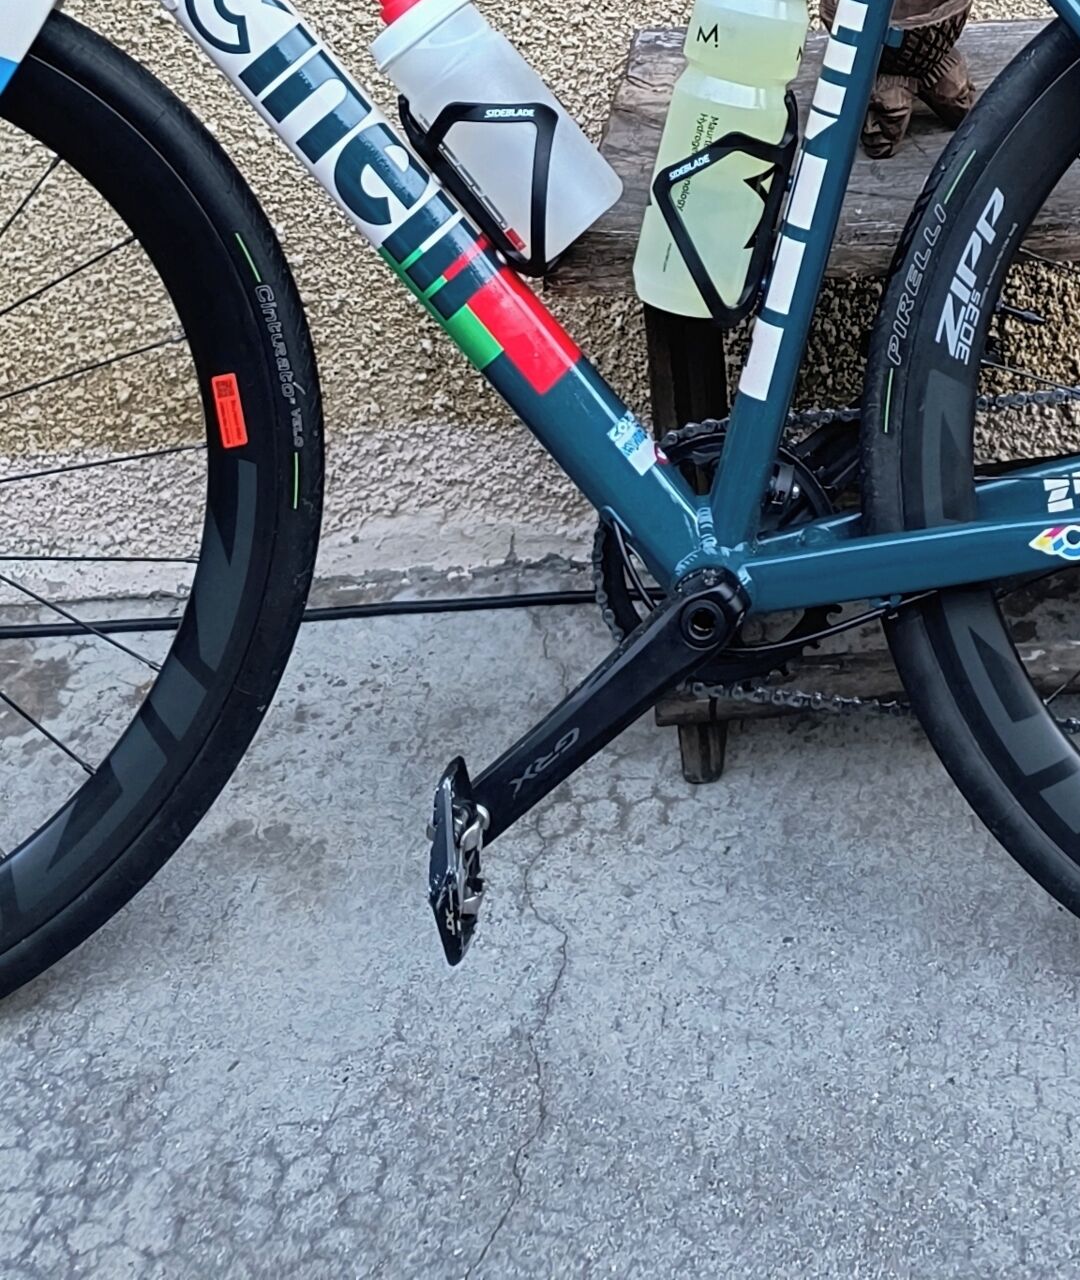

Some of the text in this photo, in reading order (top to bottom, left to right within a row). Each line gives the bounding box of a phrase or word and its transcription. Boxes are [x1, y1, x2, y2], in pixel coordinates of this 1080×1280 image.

[484, 108, 536, 119] SIDEBLADE
[692, 113, 709, 157] Hydroge
[703, 116, 719, 148] Maurt
[669, 153, 711, 181] SIDEBLADE
[887, 203, 947, 366] PIRELLI
[935, 187, 1005, 357] ZIPP
[509, 727, 580, 800] GRX
